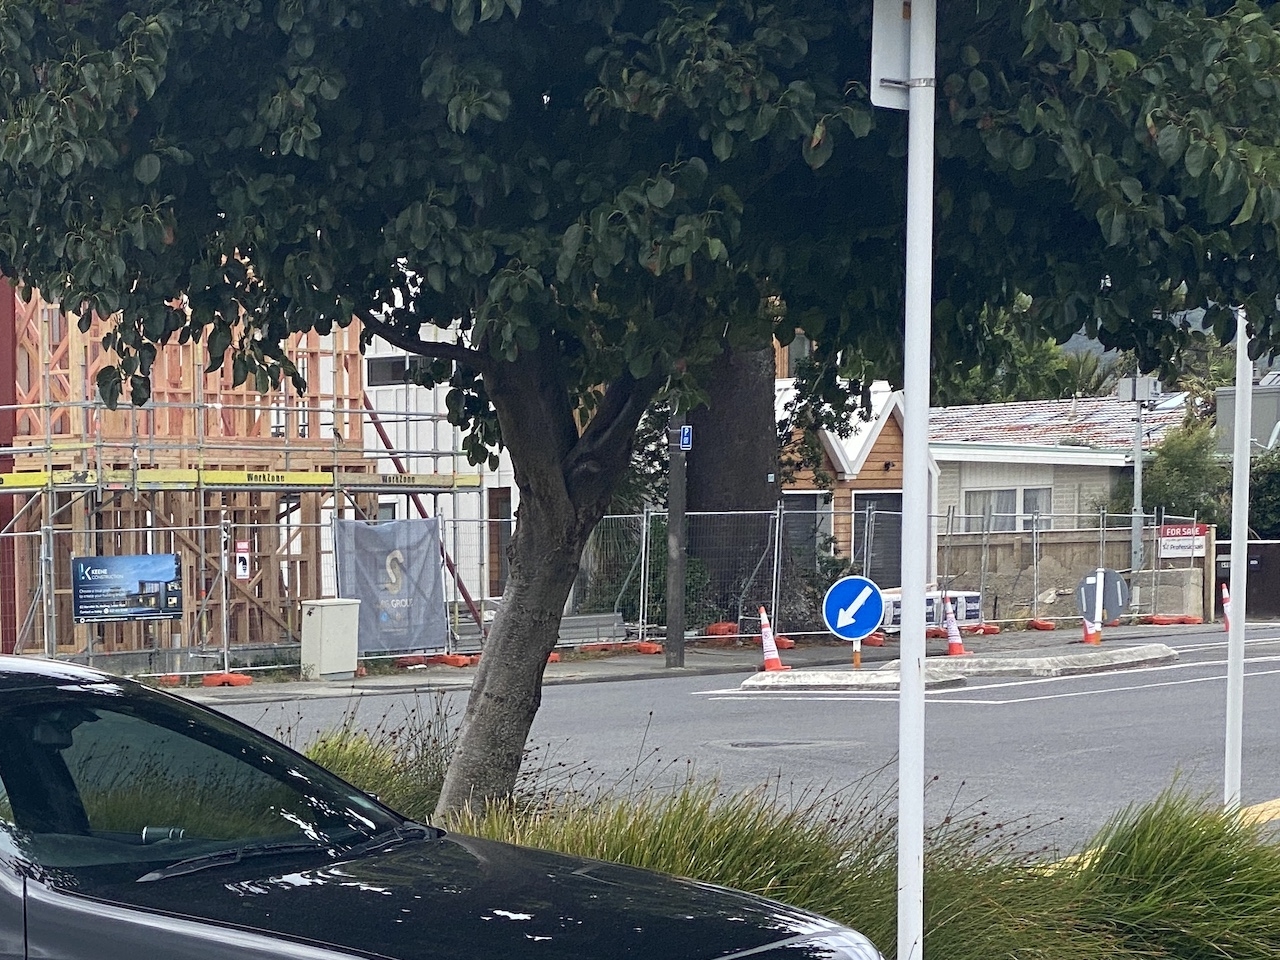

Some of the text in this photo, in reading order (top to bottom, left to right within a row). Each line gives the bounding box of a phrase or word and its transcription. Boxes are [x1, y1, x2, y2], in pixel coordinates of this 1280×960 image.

[247, 473, 285, 482] WorkZone
[381, 474, 416, 484] WorkZone
[1166, 527, 1200, 536] FOR SALE
